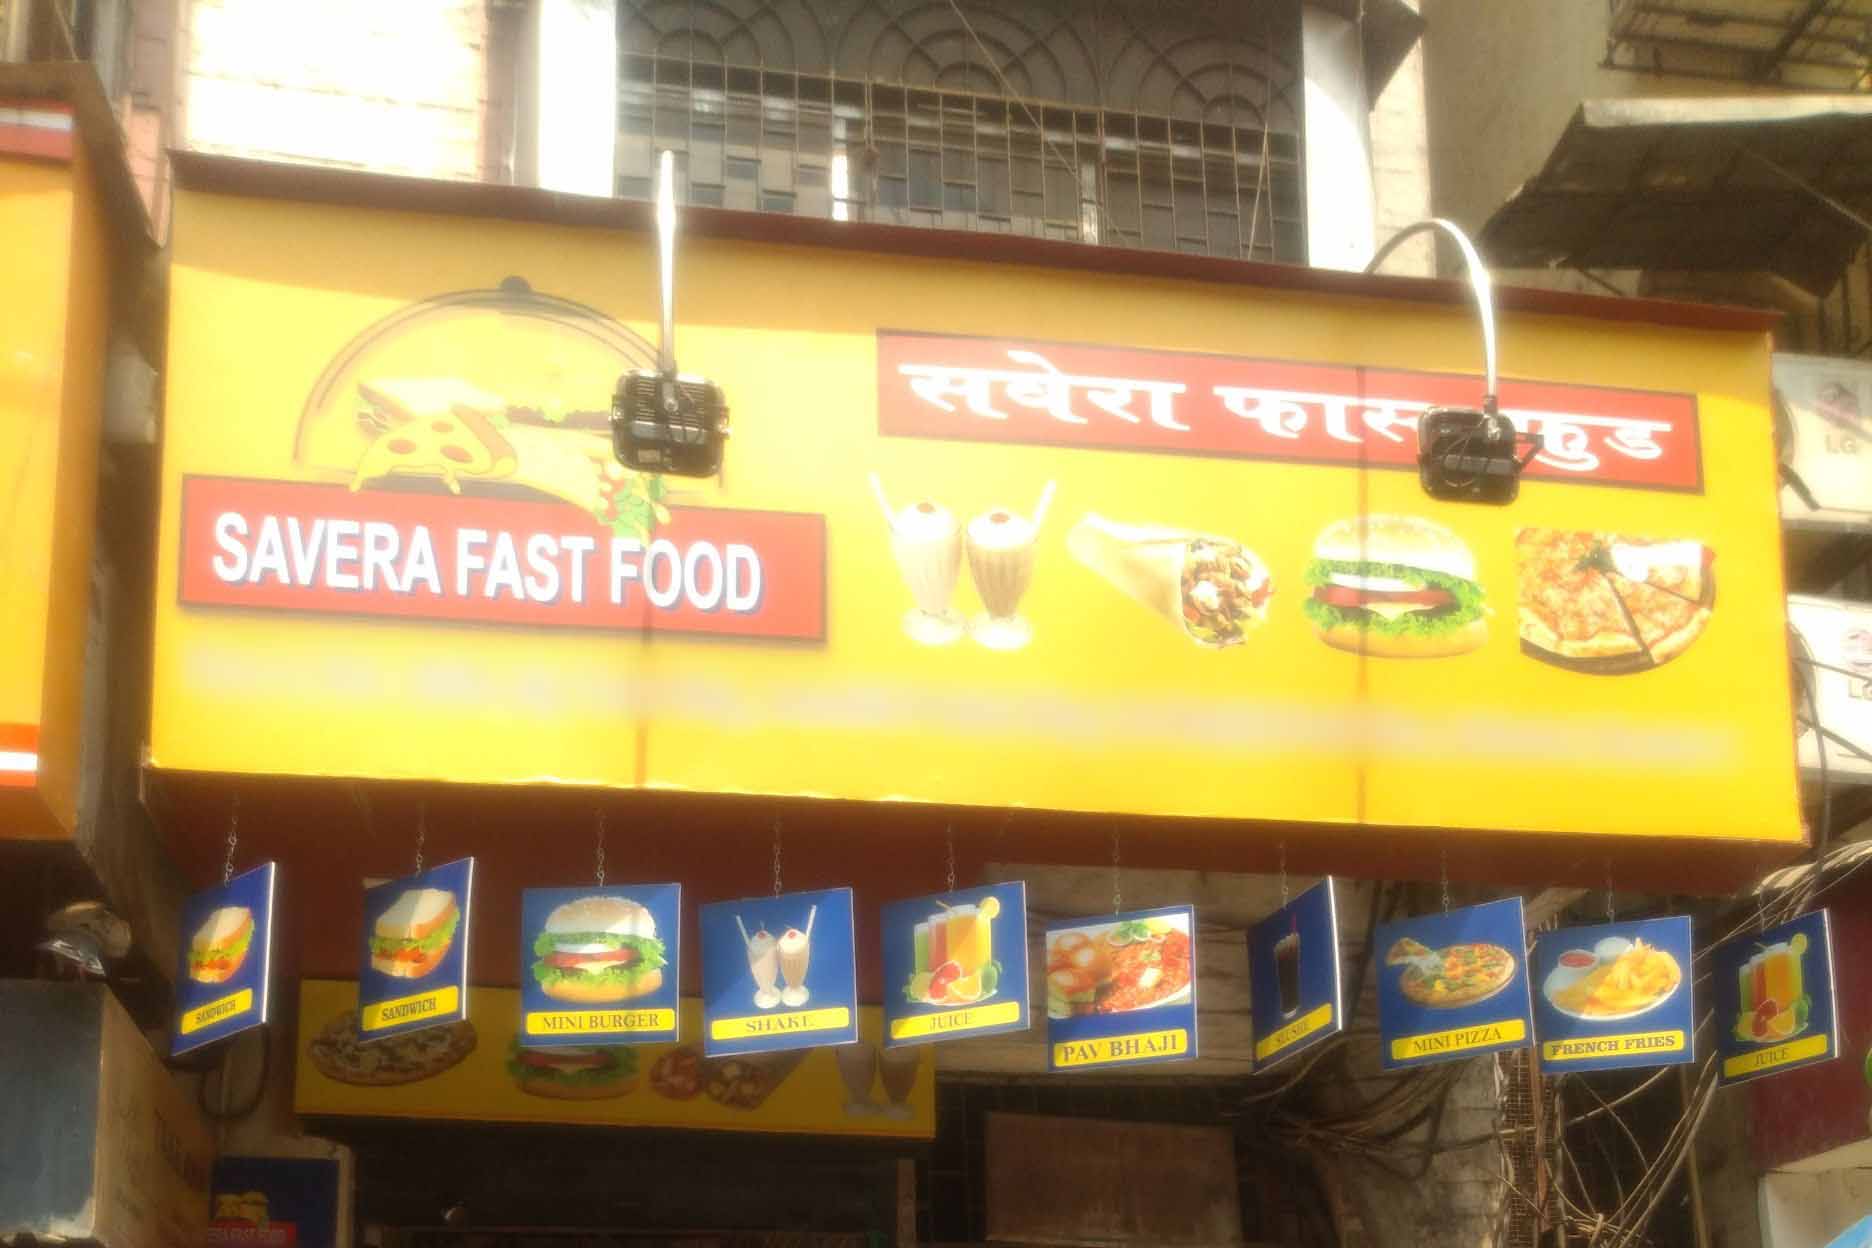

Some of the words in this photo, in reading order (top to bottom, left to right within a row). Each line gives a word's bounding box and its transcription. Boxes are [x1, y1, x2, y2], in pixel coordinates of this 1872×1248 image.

[898, 349, 1193, 435] सवेरा
[1825, 433, 1859, 456] LG
[212, 510, 442, 596] SAVERA
[456, 527, 595, 604] FAST
[609, 536, 763, 613] FOOD
[194, 997, 237, 1026] SANDWICH
[381, 994, 438, 1023] SANDWICH
[542, 1012, 584, 1030] MINI
[587, 1011, 660, 1030] BURGER
[928, 1011, 973, 1032] JUICE
[744, 1013, 815, 1036] SHAKE
[1061, 1036, 1104, 1064] PAV
[1109, 1033, 1179, 1060] BHAJI
[1414, 1031, 1449, 1054] MINI
[1452, 1026, 1503, 1049] PIZZA
[1550, 1040, 1620, 1058] FRENCH
[1623, 1033, 1675, 1053] FRIES
[1752, 1046, 1789, 1068] JUICE
